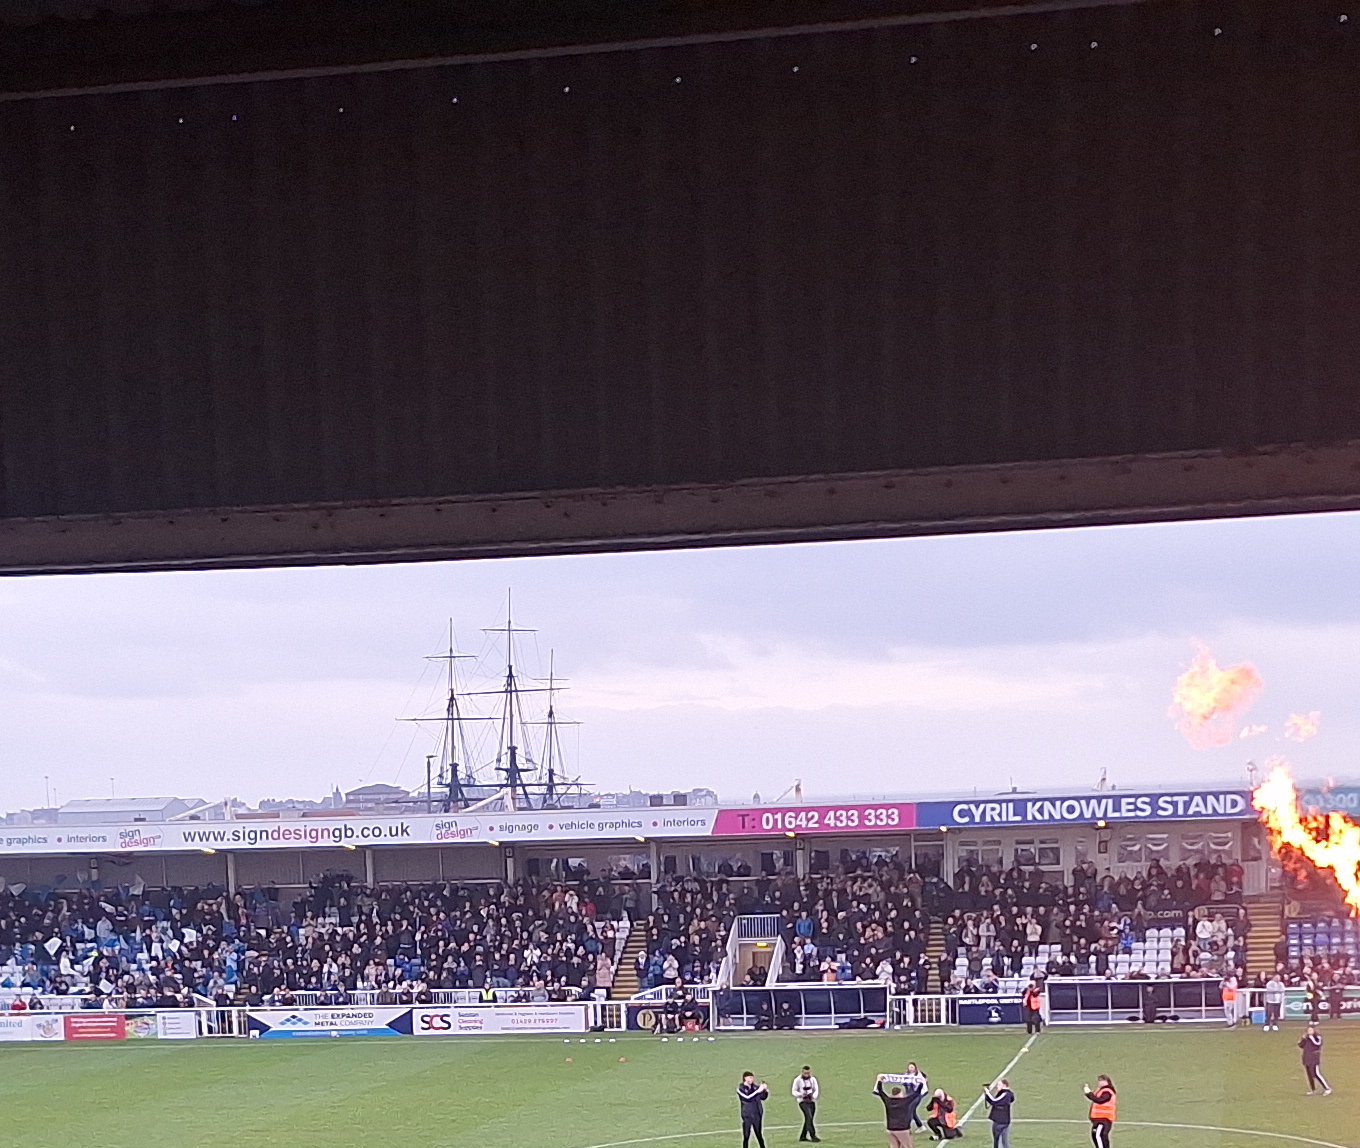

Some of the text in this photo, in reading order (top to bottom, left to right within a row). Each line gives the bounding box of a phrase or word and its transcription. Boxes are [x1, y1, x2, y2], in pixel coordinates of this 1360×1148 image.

[952, 794, 1246, 824] CYRIL KNOWLES STAND
[558, 819, 643, 832] vehicle graphics
[662, 817, 707, 828] interiors
[737, 808, 899, 830] T: 01642 433 333
[435, 820, 457, 832] sign
[498, 822, 539, 833] signage
[66, 834, 107, 843] interiors
[119, 828, 141, 841] sign
[182, 822, 411, 845] www.signdesigngb.co.uk
[435, 826, 472, 841] design
[6, 834, 48, 847] graphics
[120, 836, 156, 849] design
[330, 1012, 374, 1020] EXPANDED
[420, 1014, 452, 1031] SCS
[340, 1019, 375, 1027] COMPANY
